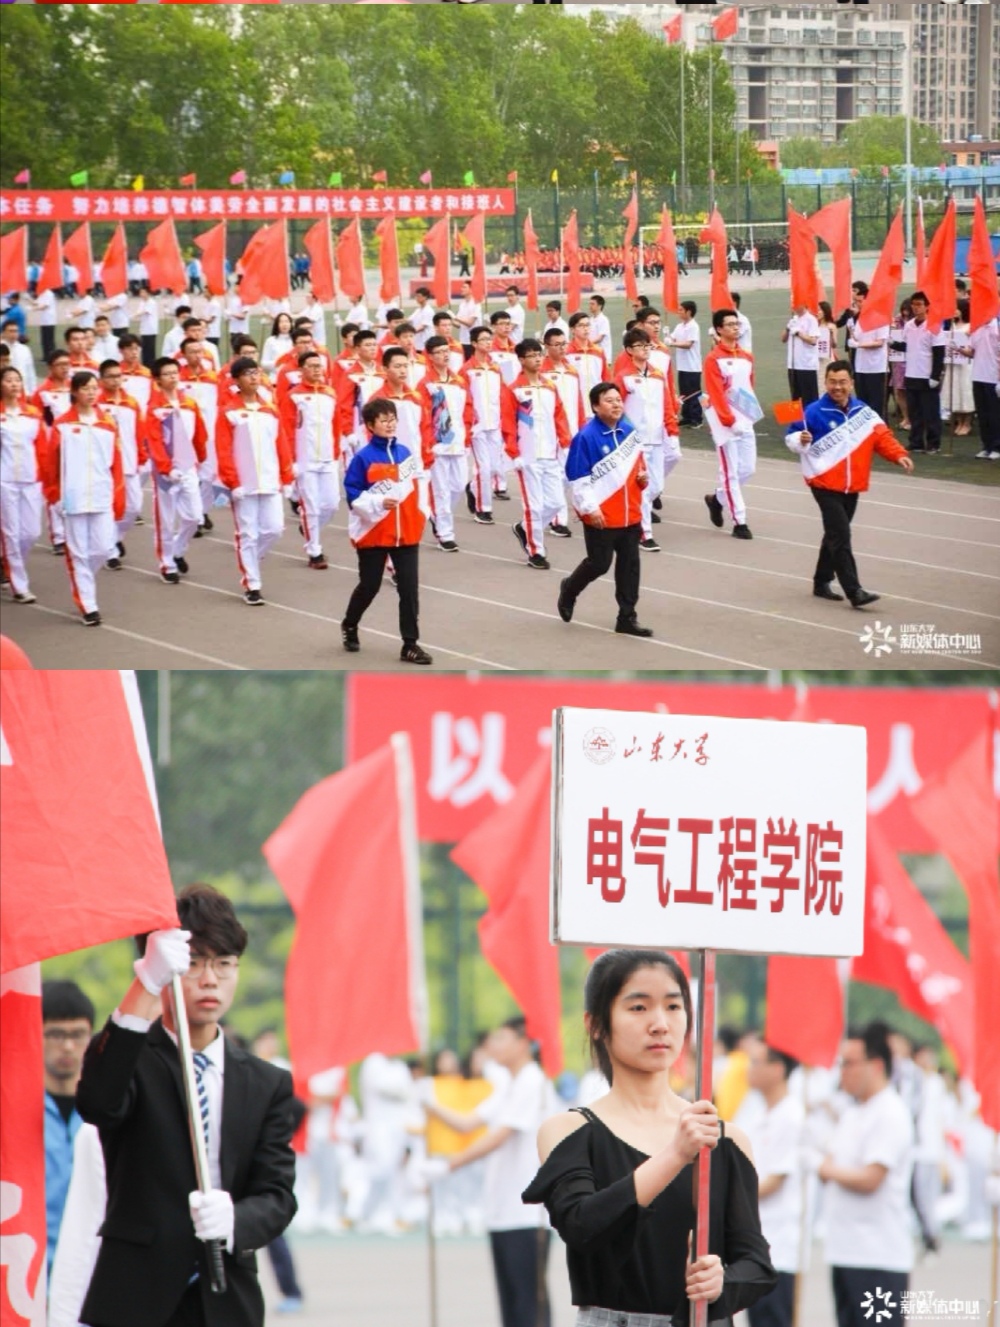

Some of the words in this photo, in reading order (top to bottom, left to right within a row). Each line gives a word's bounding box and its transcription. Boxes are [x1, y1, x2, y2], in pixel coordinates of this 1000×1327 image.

[427, 711, 514, 808] 以
[623, 731, 710, 766] 山东大学
[586, 806, 843, 916] 电气工程学院
